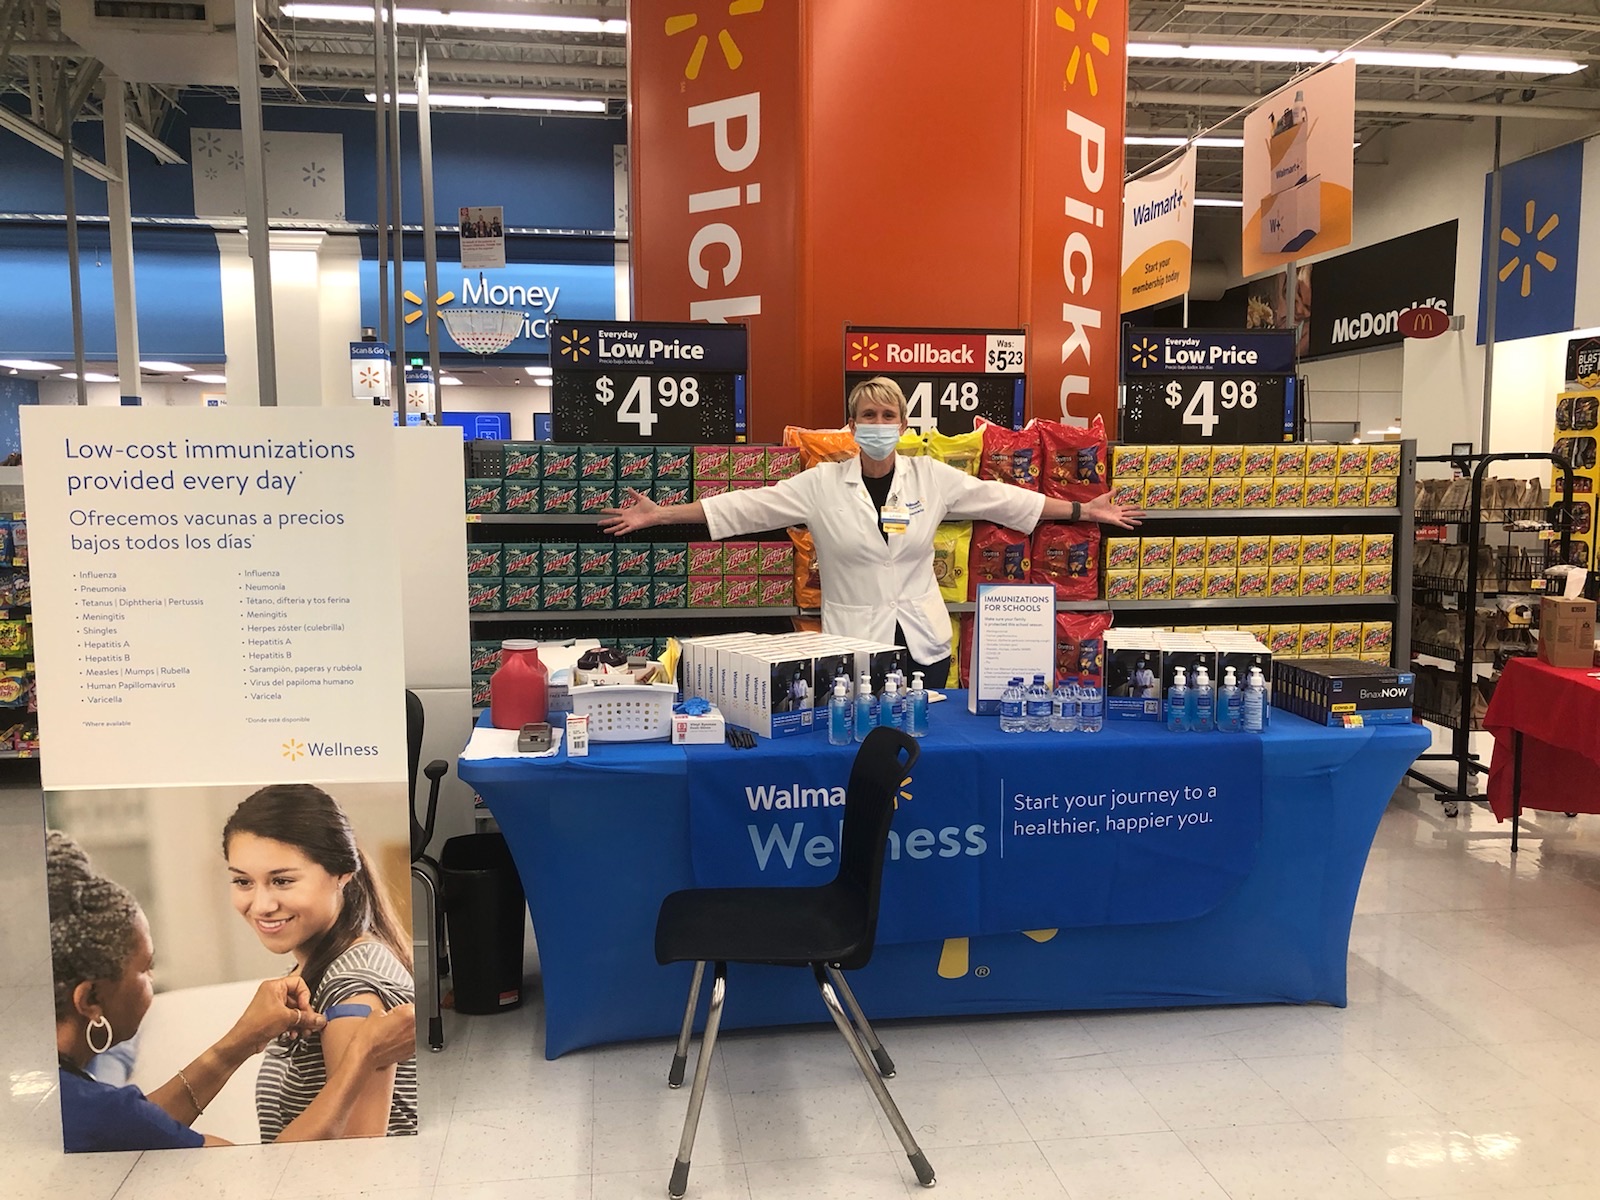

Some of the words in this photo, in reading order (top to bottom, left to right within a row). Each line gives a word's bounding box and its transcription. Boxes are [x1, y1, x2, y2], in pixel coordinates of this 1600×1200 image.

[1144, 261, 1158, 274] Start
[1159, 257, 1171, 273] your
[1132, 275, 1164, 295] membership
[1165, 270, 1181, 285] today
[461, 277, 560, 314] Money
[598, 330, 638, 341] Everyday
[996, 339, 1014, 348] Was:
[1165, 337, 1201, 347] Everyday
[598, 338, 645, 358] Low
[649, 339, 704, 360] Price
[886, 343, 974, 364] Rollback
[1164, 346, 1206, 364] Low
[1209, 345, 1258, 364] Price
[1578, 364, 1593, 375] OFF
[65, 438, 178, 459] Low-cost
[185, 439, 355, 459] immunizations
[67, 470, 175, 496] provided
[183, 475, 249, 496] every
[69, 509, 179, 526] Ofrecemos
[184, 513, 257, 525] vacunas
[263, 514, 272, 525] a
[278, 509, 345, 530] precios
[71, 534, 120, 554] bajos
[126, 534, 180, 549] todos
[186, 533, 211, 549] los
[79, 571, 117, 579] Influenza
[80, 585, 127, 593] Pneumonia
[82, 599, 113, 607] Tetanus
[119, 598, 162, 608] Diphtheria
[168, 598, 204, 606] Pertussis
[327, 596, 350, 604] ferina
[984, 595, 1050, 603] IMMUNIZATIONS
[82, 613, 125, 622] Meningitis
[246, 611, 287, 620] Meningitis
[83, 627, 117, 636] Shingles
[247, 625, 276, 633] Herpes
[278, 624, 302, 632] zóster
[303, 623, 345, 633] (culebrilla)
[84, 640, 121, 649] Hepatitis
[123, 640, 130, 648] A
[248, 638, 284, 647] Hepatitis
[85, 655, 122, 663] Hepatitis
[249, 652, 284, 661] Hepatitis
[286, 651, 292, 659] B
[86, 668, 119, 676] Measles
[124, 668, 155, 676] Mumps
[160, 667, 190, 675] Rubella
[295, 666, 325, 674] paperas
[87, 682, 117, 690] Human
[118, 681, 176, 690] Papillomavirus
[286, 679, 321, 687] papiloma
[1360, 687, 1408, 699] BinaxNOW
[87, 696, 122, 704] Varicella
[307, 742, 379, 756] Wellness
[745, 784, 846, 811] Walma
[1013, 793, 1059, 811] Start
[1064, 793, 1107, 813] your
[1110, 789, 1180, 810] journey
[1183, 786, 1203, 799] to
[1207, 786, 1217, 798] a
[1013, 817, 1100, 836] healthier,
[1106, 812, 1173, 834] happier
[1177, 812, 1213, 830] you.
[747, 820, 987, 871] Weness
